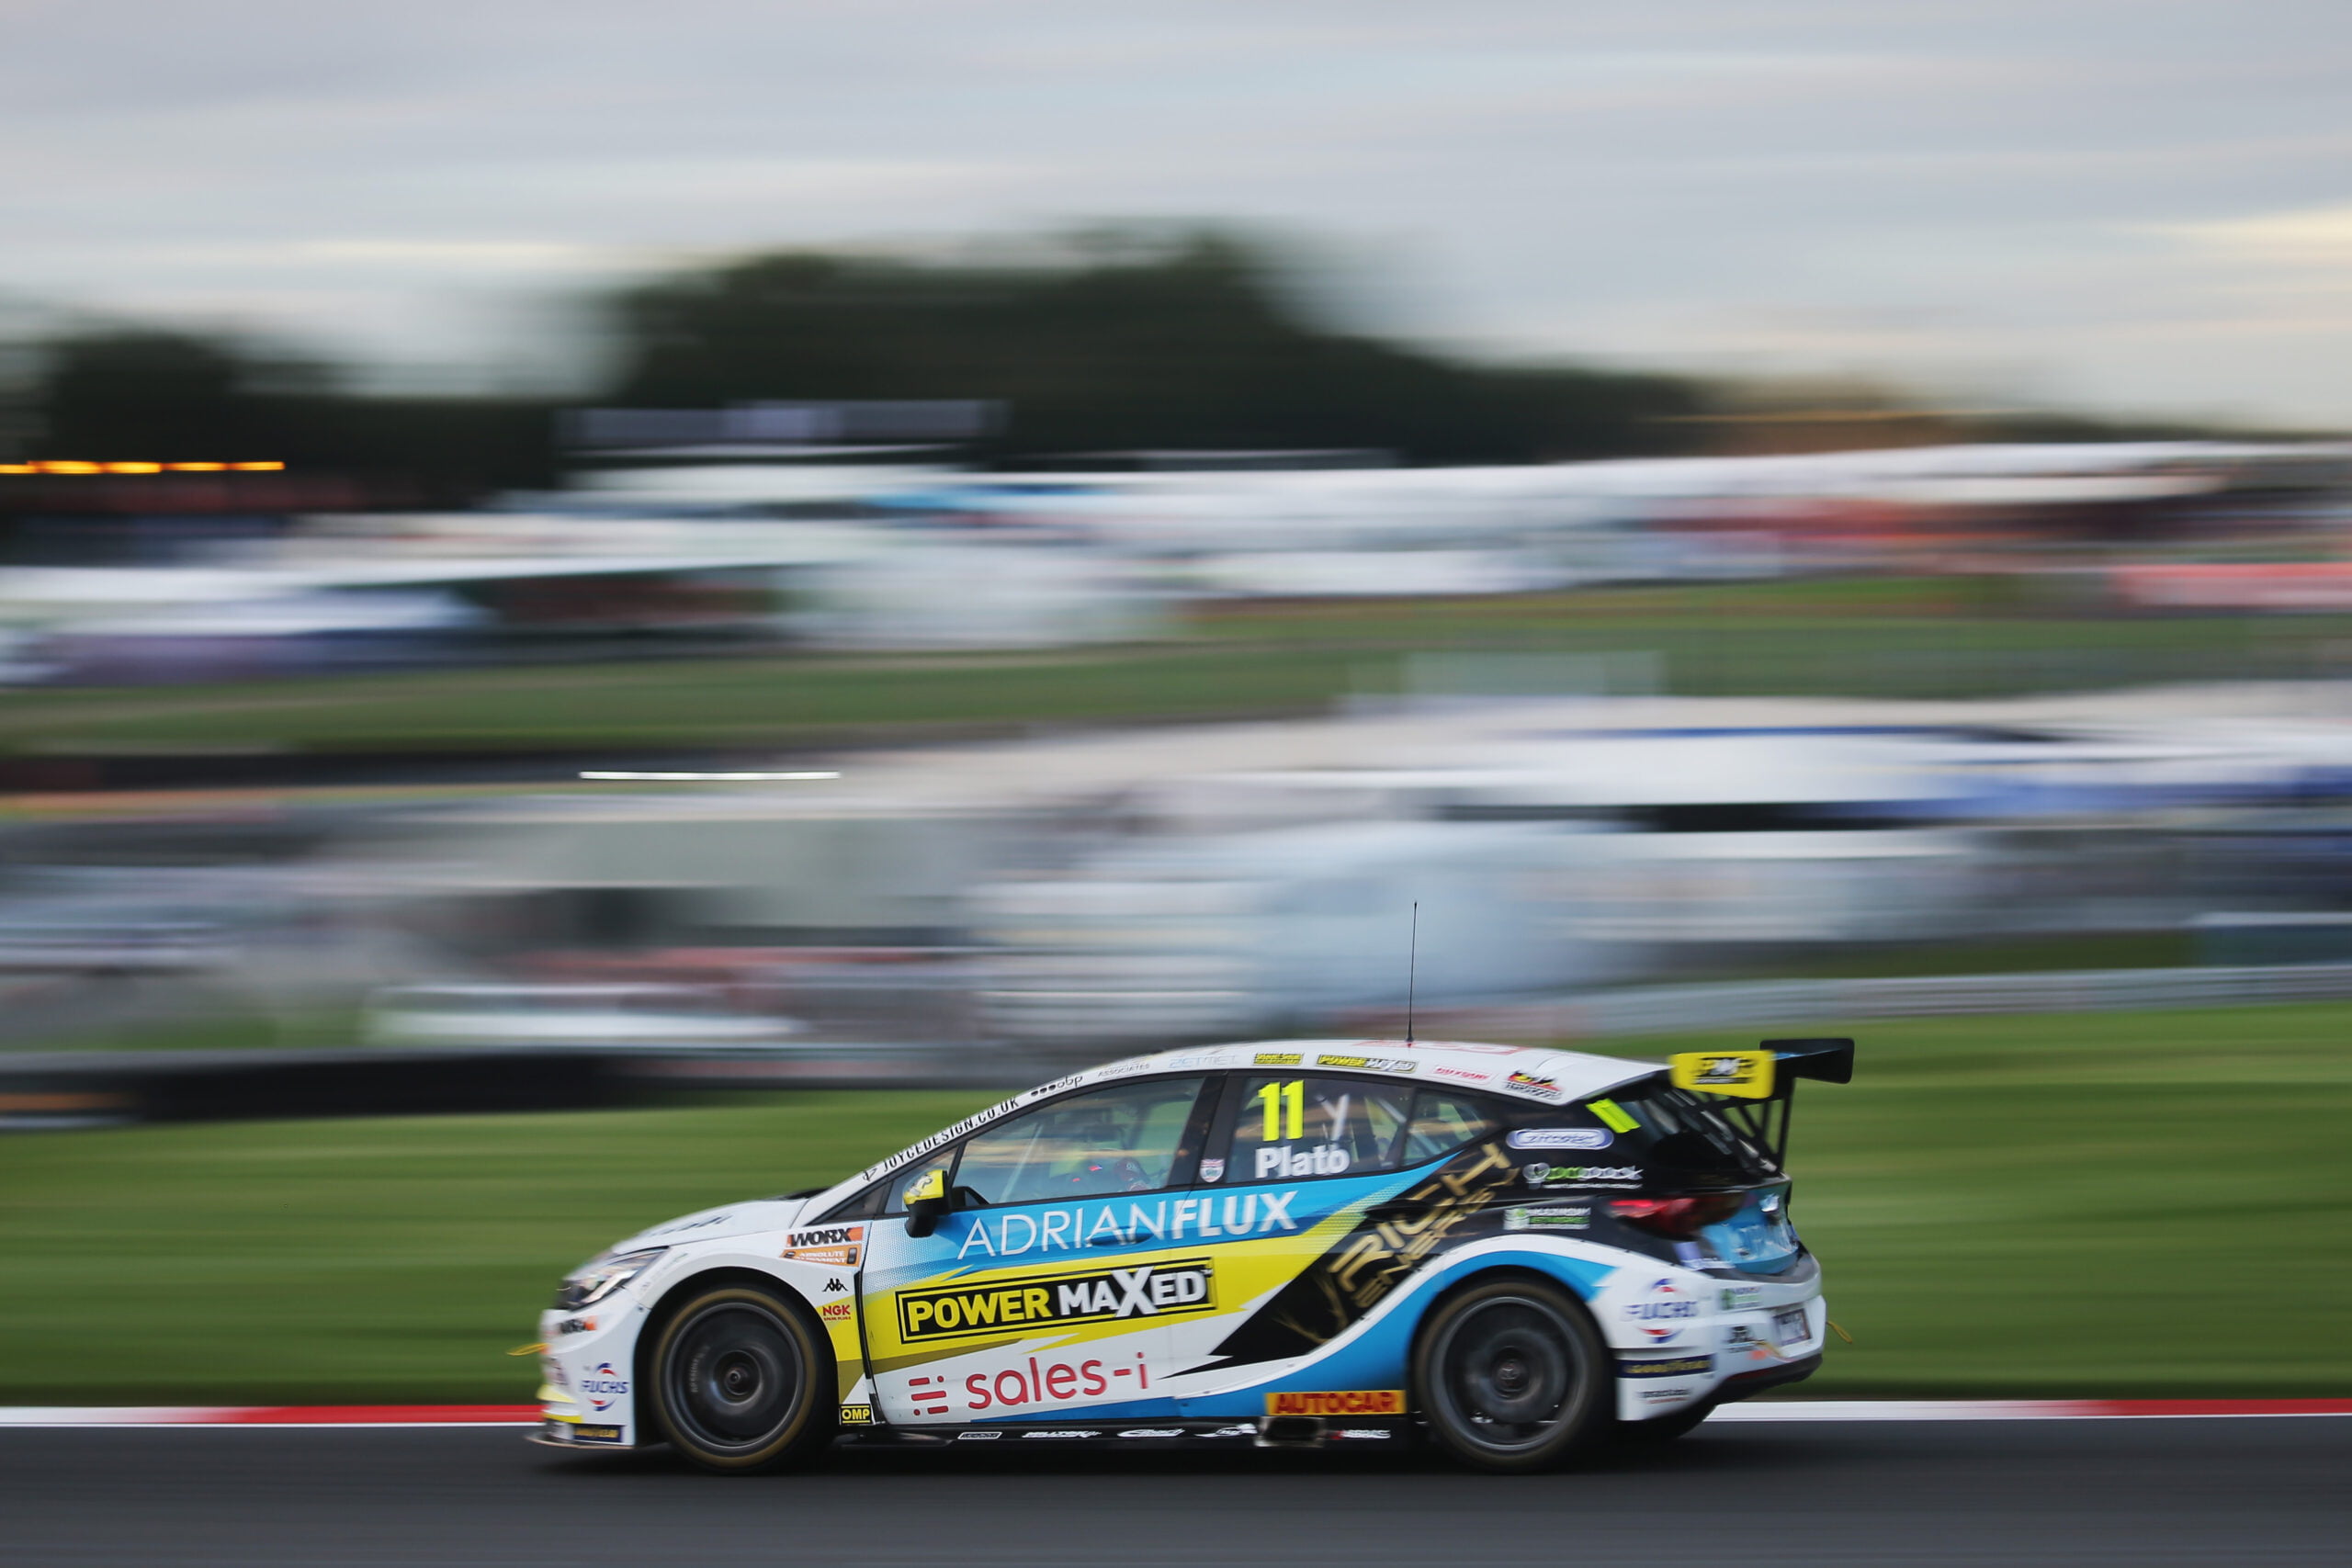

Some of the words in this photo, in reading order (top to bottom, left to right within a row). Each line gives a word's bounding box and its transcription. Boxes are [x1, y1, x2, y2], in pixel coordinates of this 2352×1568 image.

[1257, 1079, 1305, 1142] 11
[1255, 1145, 1351, 1179] Plato
[791, 1227, 852, 1247] WORX
[822, 1304, 851, 1316] NGK
[907, 1287, 1053, 1332] POWER
[1058, 1266, 1208, 1318] MAXED
[580, 1380, 629, 1393] FUCHS
[965, 1351, 1148, 1410] sales-i
[842, 1408, 871, 1420] OMP
[1275, 1392, 1398, 1415] AUTOCAR
